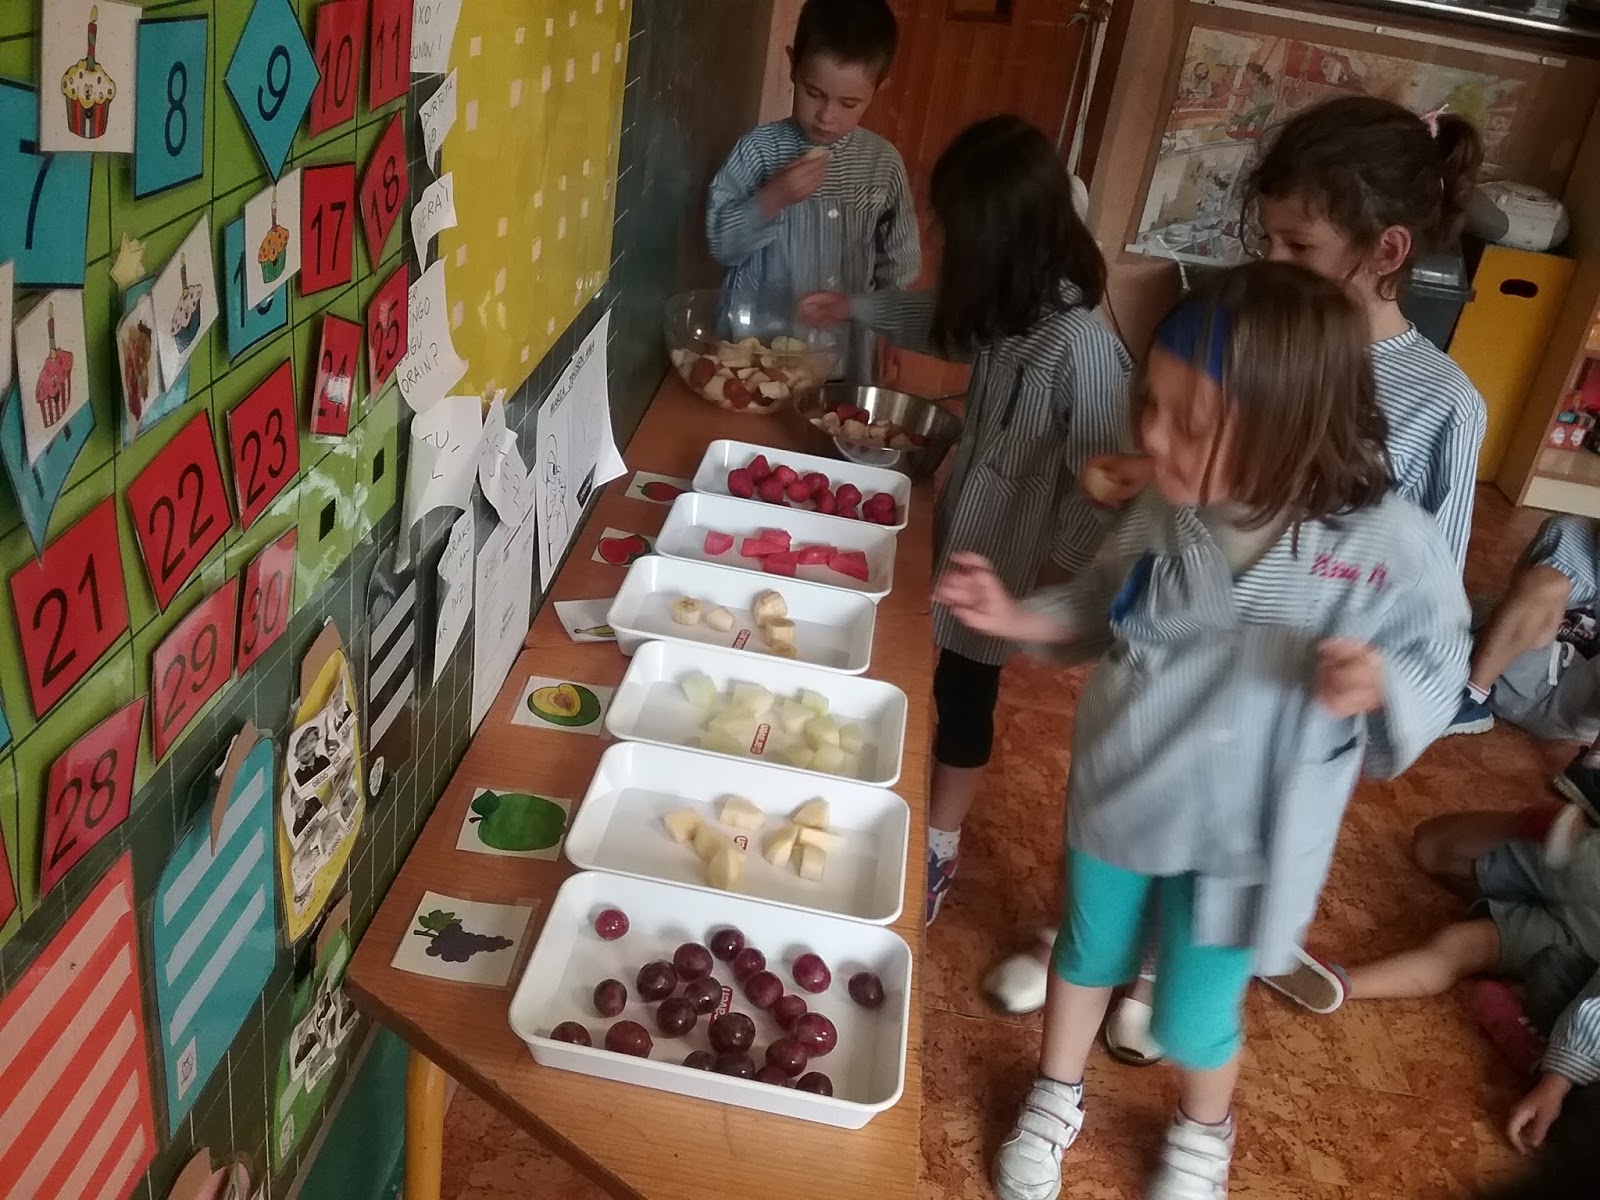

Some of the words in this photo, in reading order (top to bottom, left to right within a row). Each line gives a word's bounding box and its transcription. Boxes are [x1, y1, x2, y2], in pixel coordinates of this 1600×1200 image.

[256, 44, 292, 122] 9
[319, 33, 354, 115] 10
[375, 19, 401, 96] 11
[163, 60, 188, 157] 8
[370, 154, 400, 239] 18
[310, 201, 347, 276] 17
[373, 298, 400, 380] 25
[401, 341, 439, 394] ORAIN?
[241, 408, 287, 508] 23
[149, 462, 215, 584] 22
[32, 552, 104, 688] 21
[244, 581, 283, 653] 30
[162, 624, 219, 734] 29
[50, 748, 118, 869] 28
[311, 772, 329, 788] DIEGO
